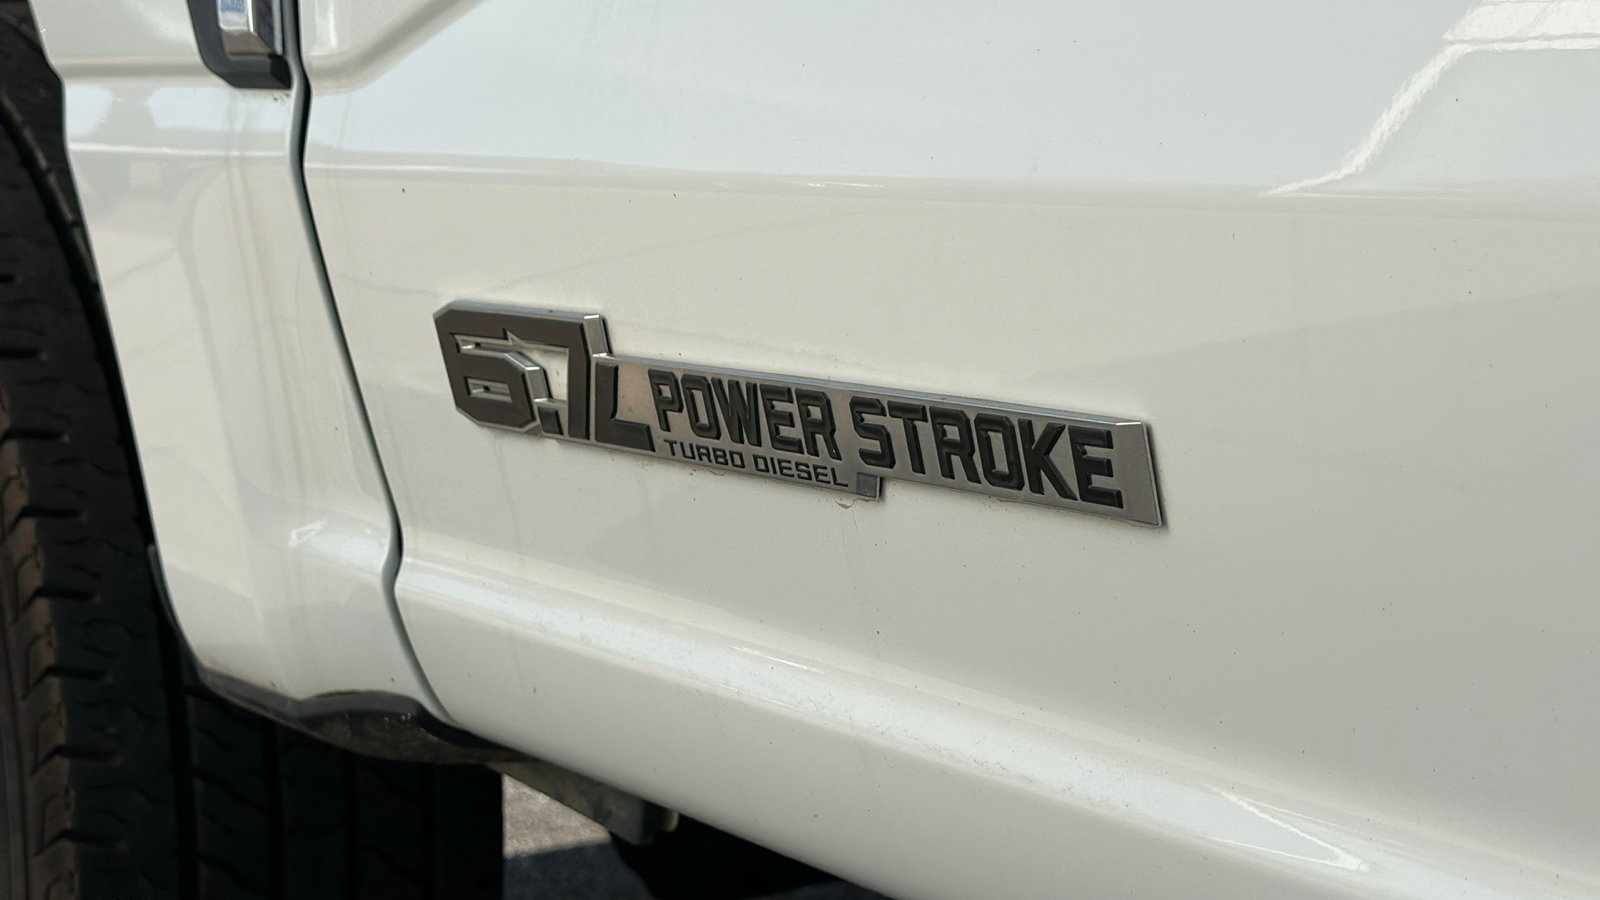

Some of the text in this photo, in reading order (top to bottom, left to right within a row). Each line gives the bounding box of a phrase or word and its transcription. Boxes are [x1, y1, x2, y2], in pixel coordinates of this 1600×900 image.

[434, 302, 1124, 509] 6.7L POWER STROKE
[664, 438, 849, 488] TURBO DIESEL
